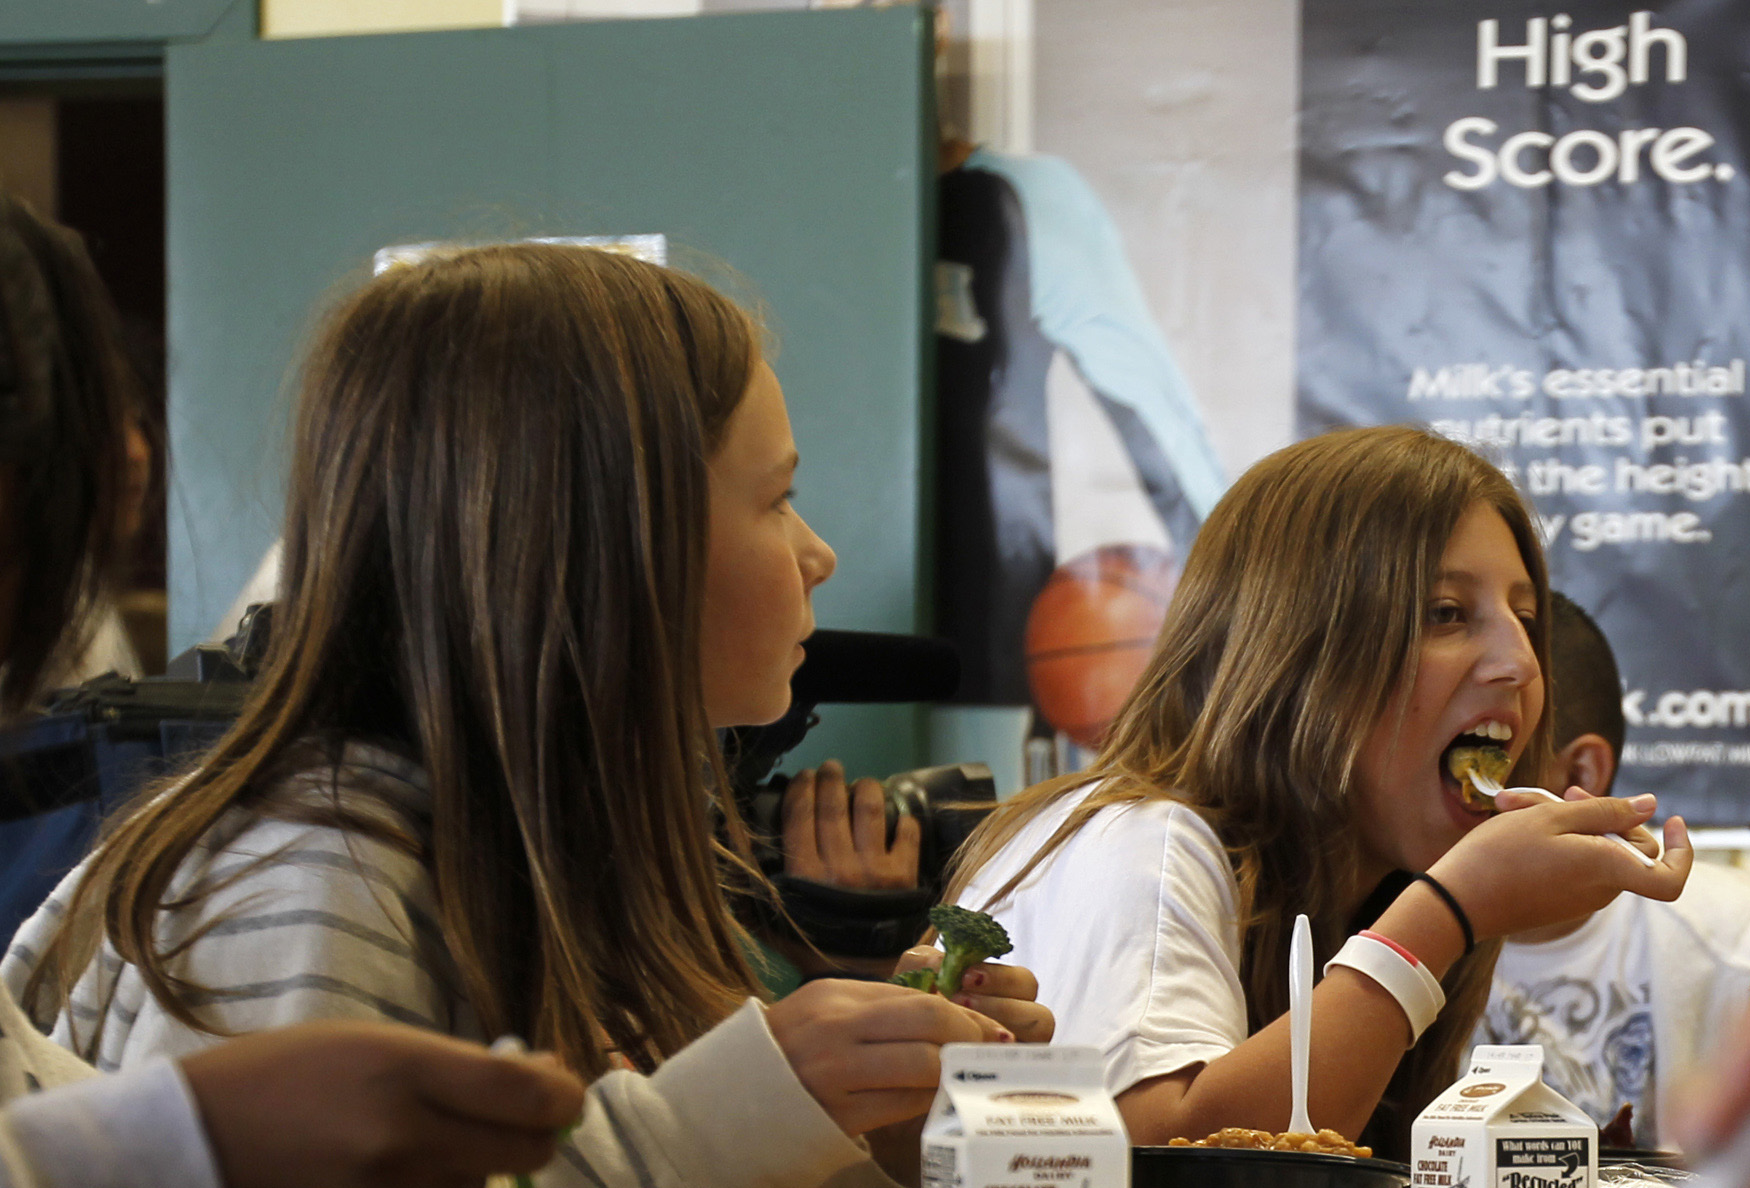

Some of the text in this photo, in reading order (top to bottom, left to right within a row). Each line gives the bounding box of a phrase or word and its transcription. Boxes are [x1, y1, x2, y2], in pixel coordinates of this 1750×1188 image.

[1477, 11, 1687, 101] High
[1443, 116, 1736, 190] Score.
[1407, 358, 1745, 400] Milk's essential
[1641, 411, 1728, 450] put
[1527, 458, 1605, 495] the
[1570, 509, 1712, 550] game.
[966, 1071, 998, 1082] Open
[985, 1115, 1098, 1126] FAT FREE MILK
[1502, 1139, 1583, 1151] What words can YOU
[1512, 1153, 1556, 1164] make from
[1417, 1160, 1448, 1172] CHOCOLATE
[1033, 1172, 1073, 1181] DAIRY
[1413, 1173, 1452, 1186] FAT FREE MILK
